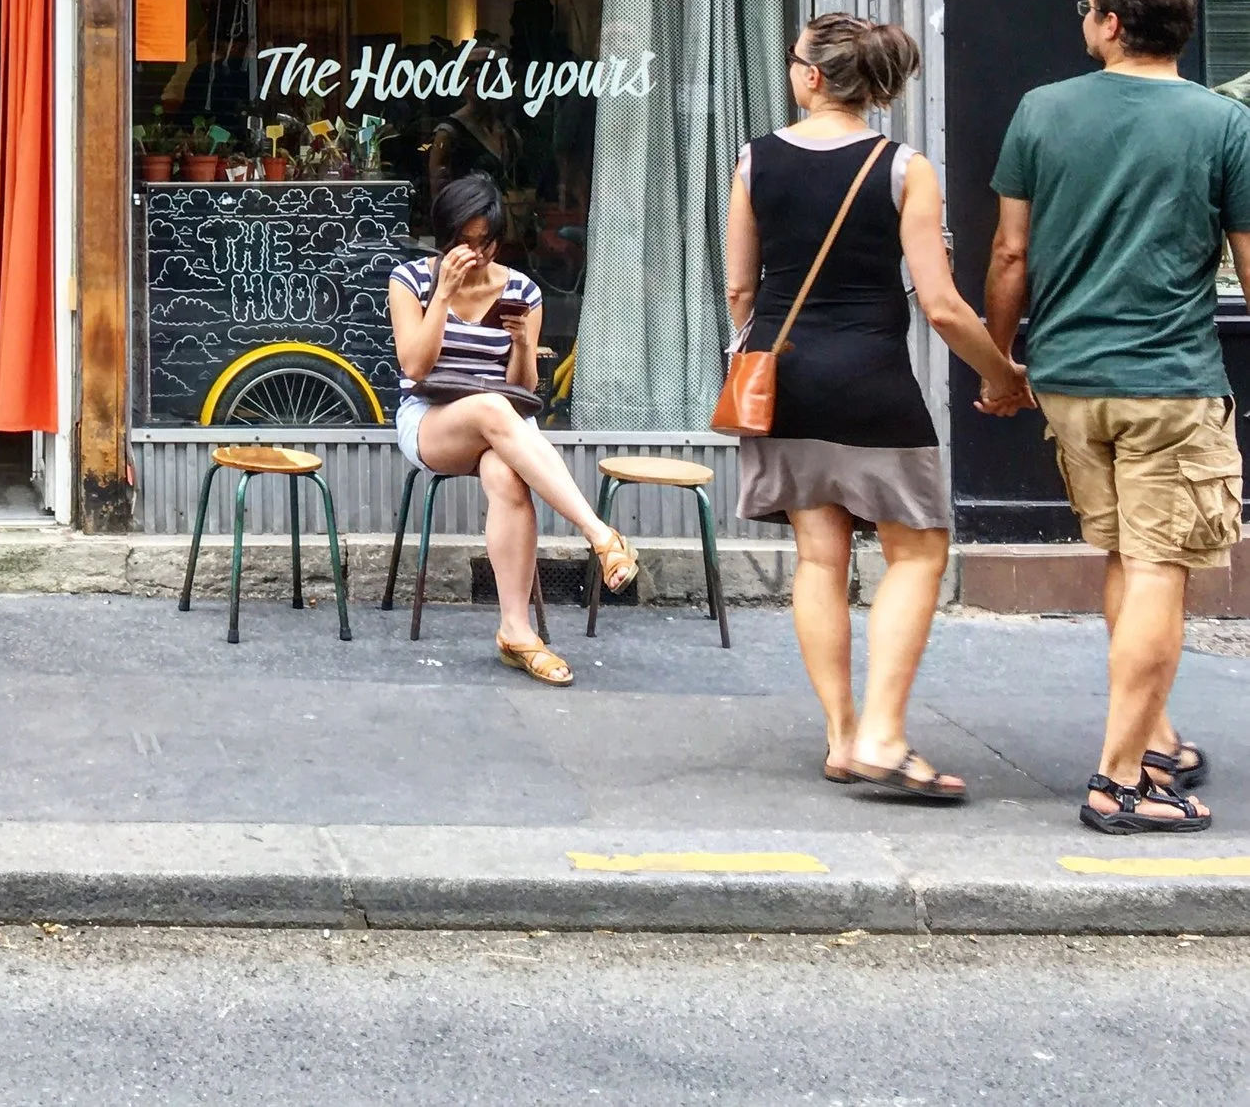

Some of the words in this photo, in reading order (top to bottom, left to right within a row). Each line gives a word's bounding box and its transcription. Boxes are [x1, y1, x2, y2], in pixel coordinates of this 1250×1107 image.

[257, 42, 341, 101] The
[345, 38, 477, 109] Hood
[476, 47, 517, 101] is
[523, 50, 657, 118] yours
[197, 219, 294, 274] THE
[231, 273, 340, 323] HOOD
